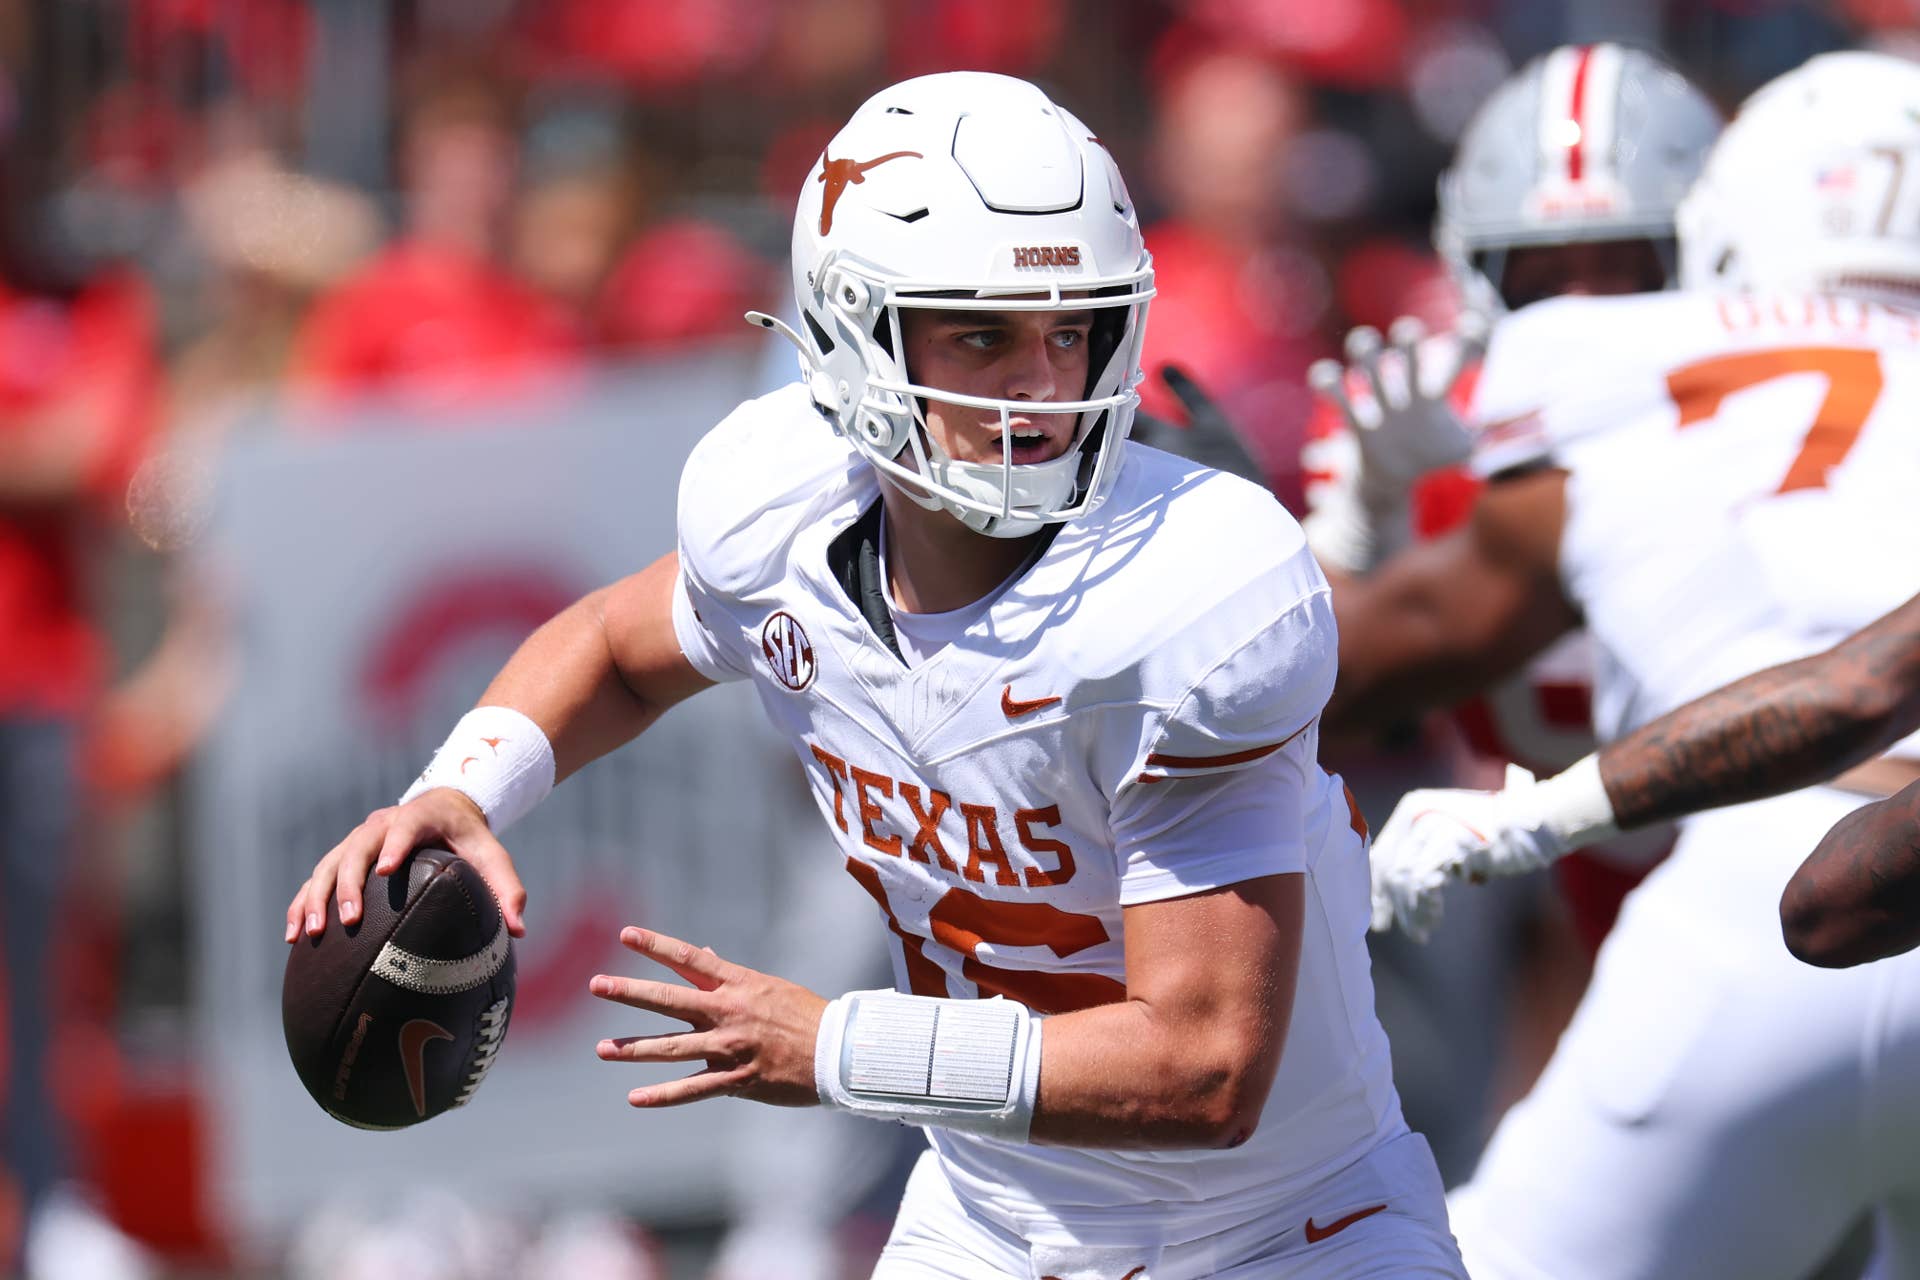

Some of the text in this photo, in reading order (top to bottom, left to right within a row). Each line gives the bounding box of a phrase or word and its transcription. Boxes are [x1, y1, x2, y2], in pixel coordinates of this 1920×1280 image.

[1013, 246, 1081, 268] HORNS
[763, 612, 814, 690] SEC
[810, 743, 1077, 888] TEXAS
